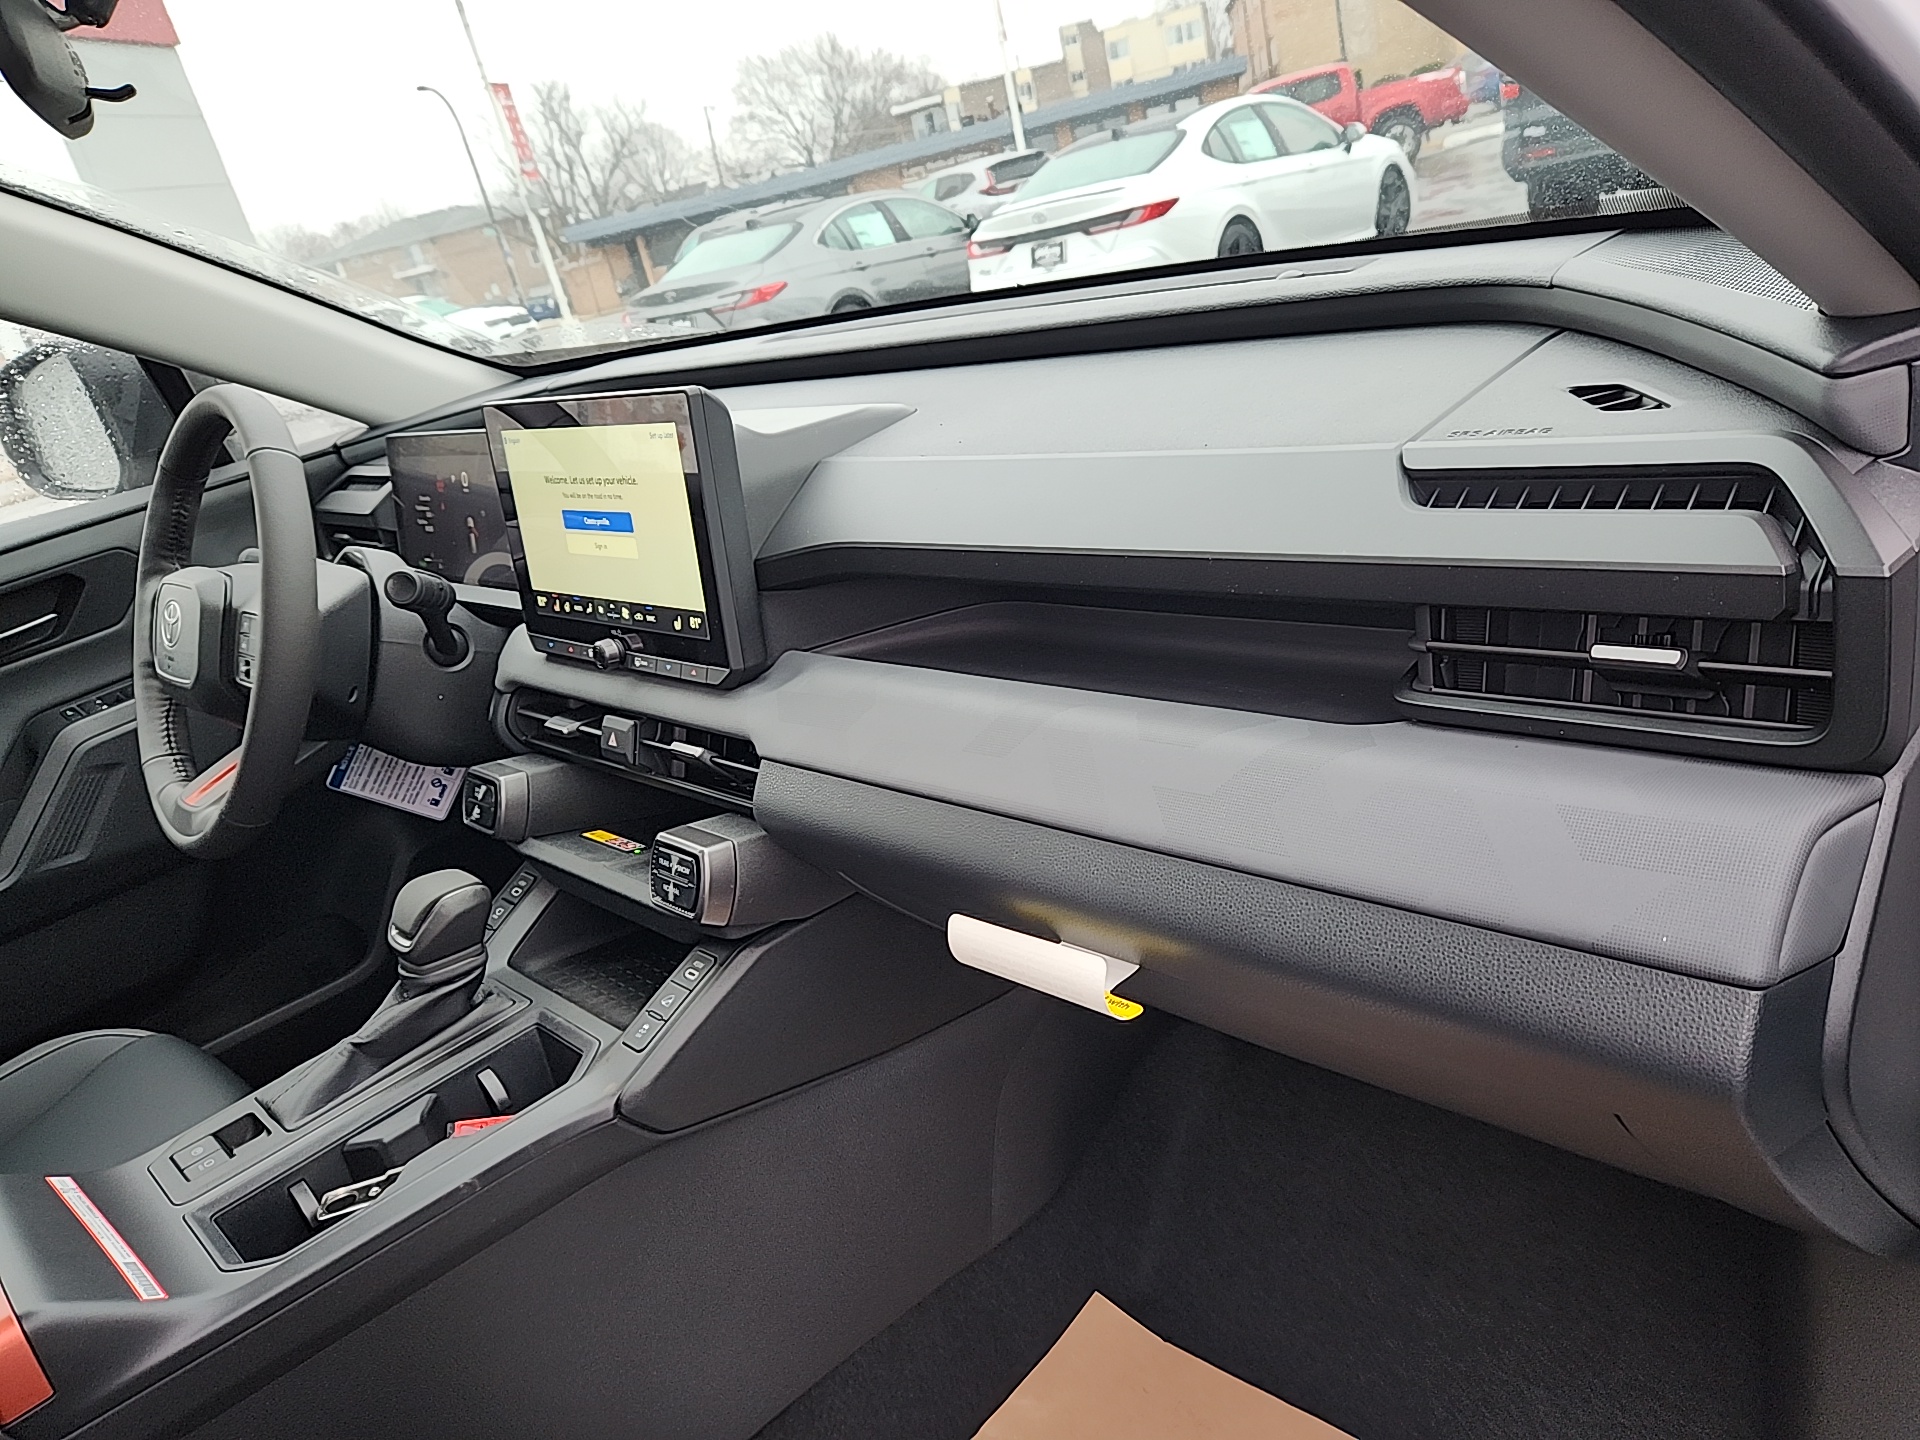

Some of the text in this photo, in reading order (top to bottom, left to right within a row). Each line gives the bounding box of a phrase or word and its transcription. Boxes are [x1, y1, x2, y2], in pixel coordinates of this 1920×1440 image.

[1447, 427, 1553, 438] SRS AIRBAG
[543, 474, 639, 488] Welcome. Let us set up your vehicle.
